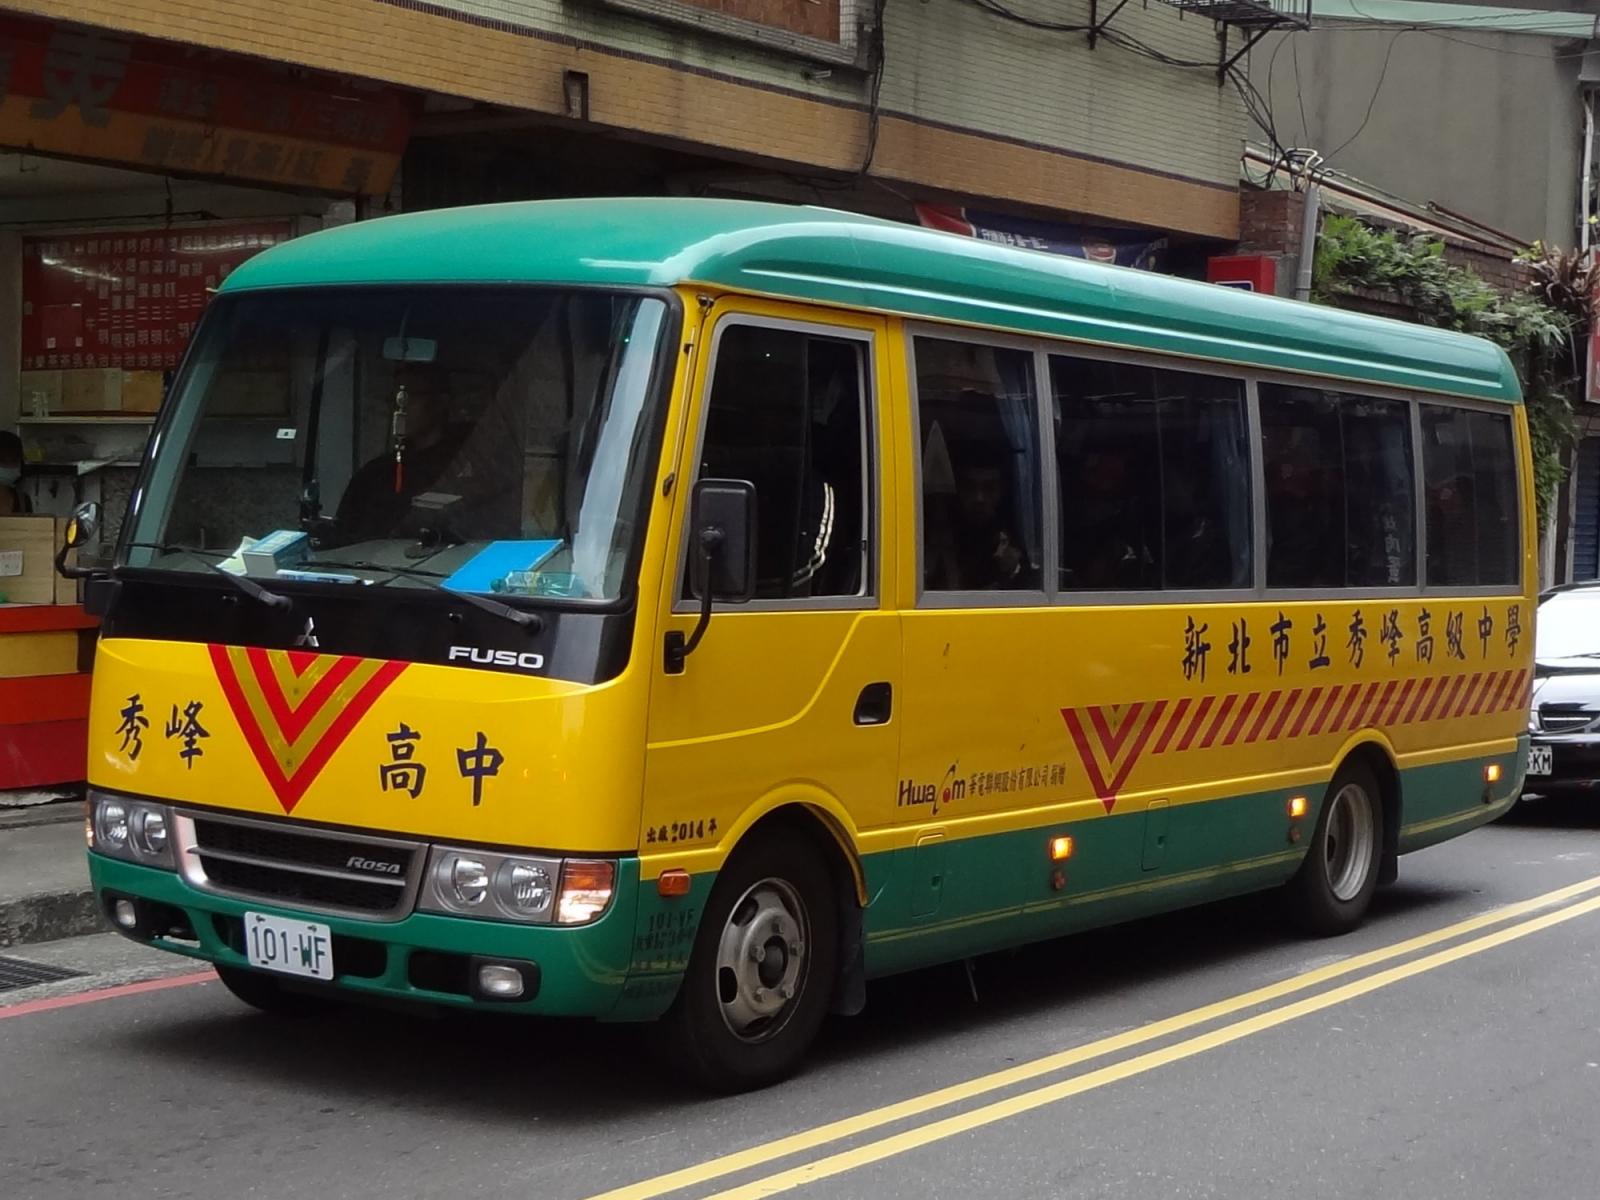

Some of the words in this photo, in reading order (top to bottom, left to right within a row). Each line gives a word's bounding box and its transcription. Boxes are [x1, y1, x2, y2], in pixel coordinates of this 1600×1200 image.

[448, 645, 544, 669] FUSO
[1182, 604, 1522, 684] 新北市立秀峰高級中學
[115, 693, 210, 770] 秀峰
[379, 722, 504, 806] 高中
[252, 926, 327, 970] 101-WF
